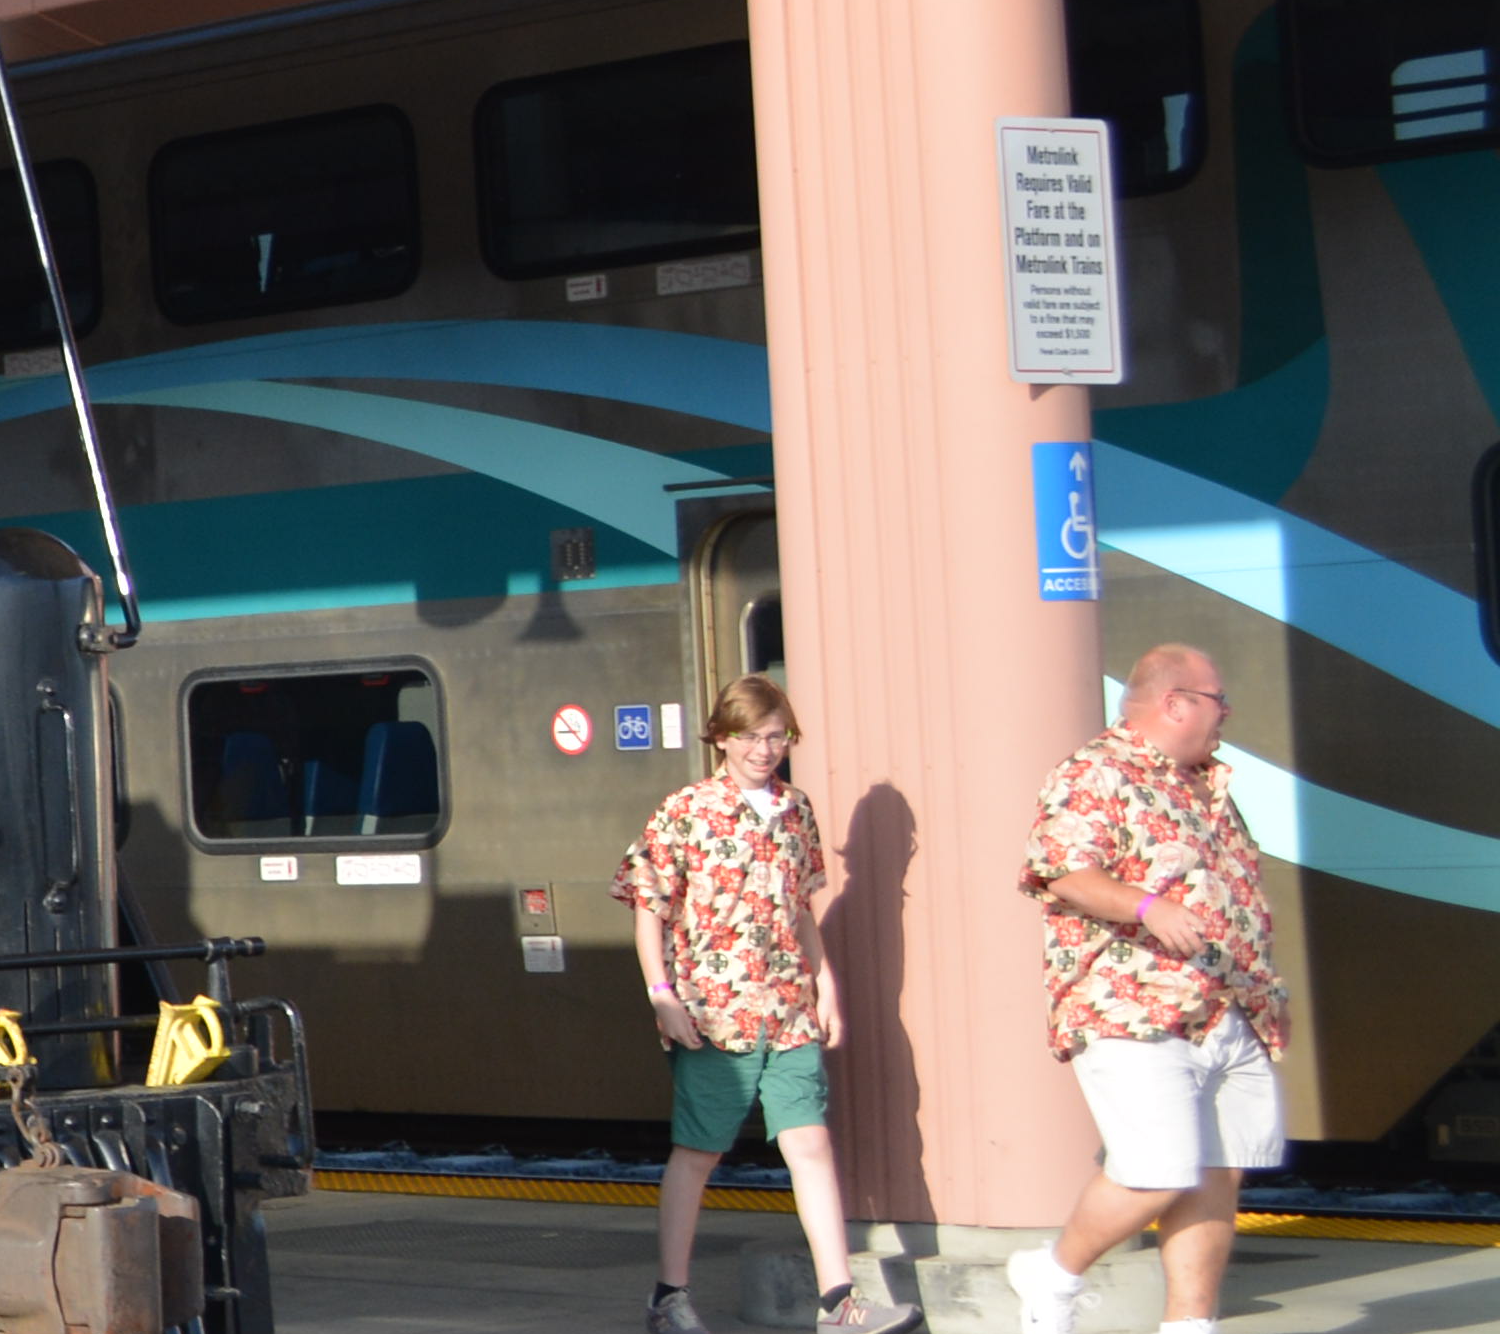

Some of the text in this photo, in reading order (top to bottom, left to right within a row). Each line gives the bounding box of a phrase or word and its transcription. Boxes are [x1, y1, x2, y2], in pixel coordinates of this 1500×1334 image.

[1026, 145, 1078, 166] Metrolink
[1016, 172, 1092, 195] Requires Valid
[1027, 200, 1086, 220] Fare at the
[1014, 227, 1100, 248] Platform and on
[1016, 254, 1103, 276] Metrolink Trains
